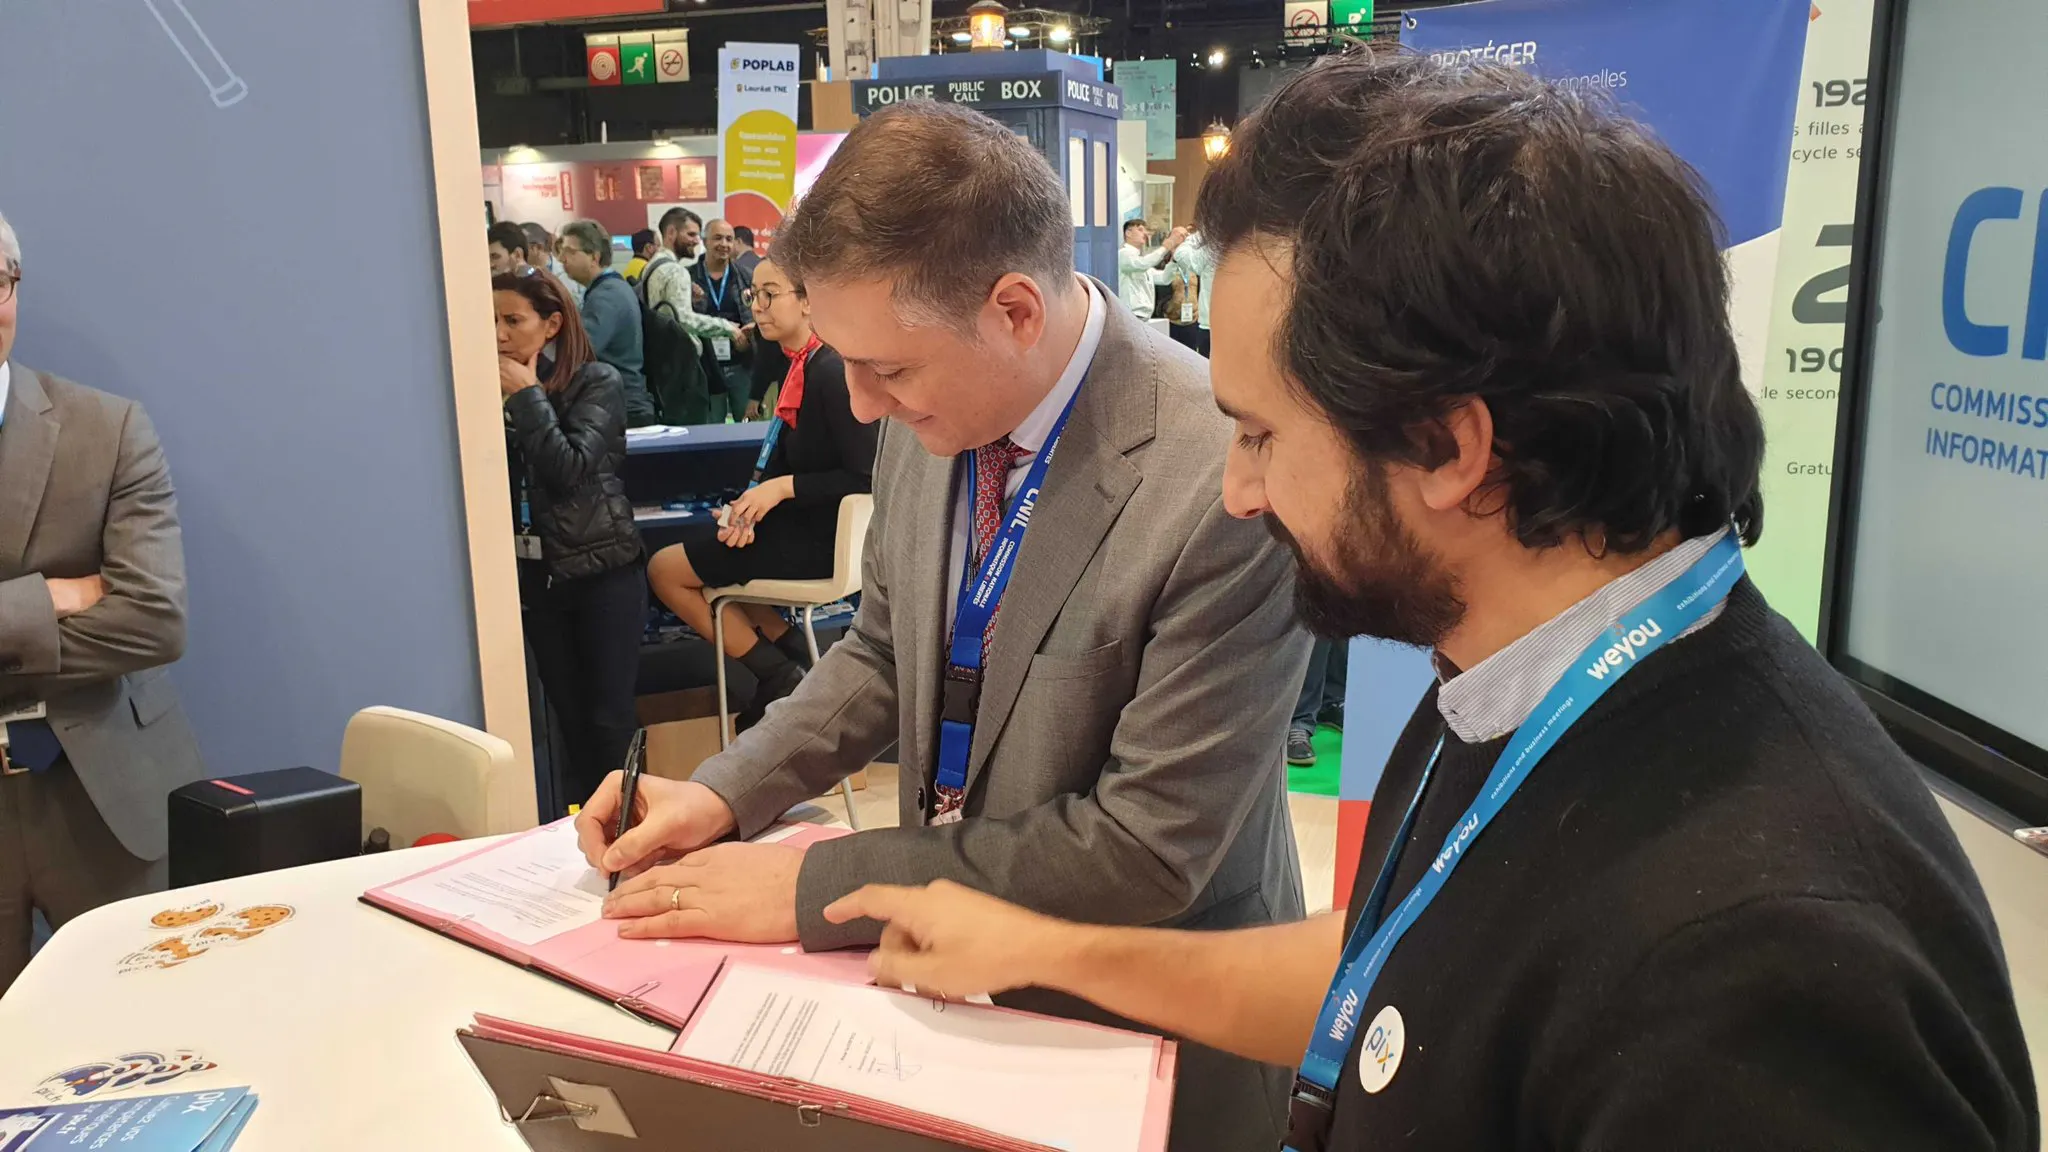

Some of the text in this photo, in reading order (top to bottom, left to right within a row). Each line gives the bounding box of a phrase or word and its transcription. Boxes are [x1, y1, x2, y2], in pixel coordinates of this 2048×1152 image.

[743, 59, 794, 71] POPLAB
[774, 85, 788, 93] TNE
[868, 84, 934, 105] POLICE
[949, 81, 984, 93] PUBLIC
[1001, 80, 1042, 100] BOX
[1067, 79, 1090, 102] POLICE
[953, 93, 980, 102] CALL
[1107, 91, 1119, 110] BOX
[1808, 121, 1850, 136] filles
[1792, 147, 1838, 163] cycle
[1942, 186, 2048, 360] C
[1786, 387, 1839, 399] secon
[1786, 461, 1832, 475] Gratu
[1586, 617, 1663, 681] weyou
[1490, 696, 1574, 800] exhibitions and business meetings
[1431, 812, 1479, 874] weyou
[1328, 988, 1359, 1041] weyou
[181, 1091, 227, 1115] pix
